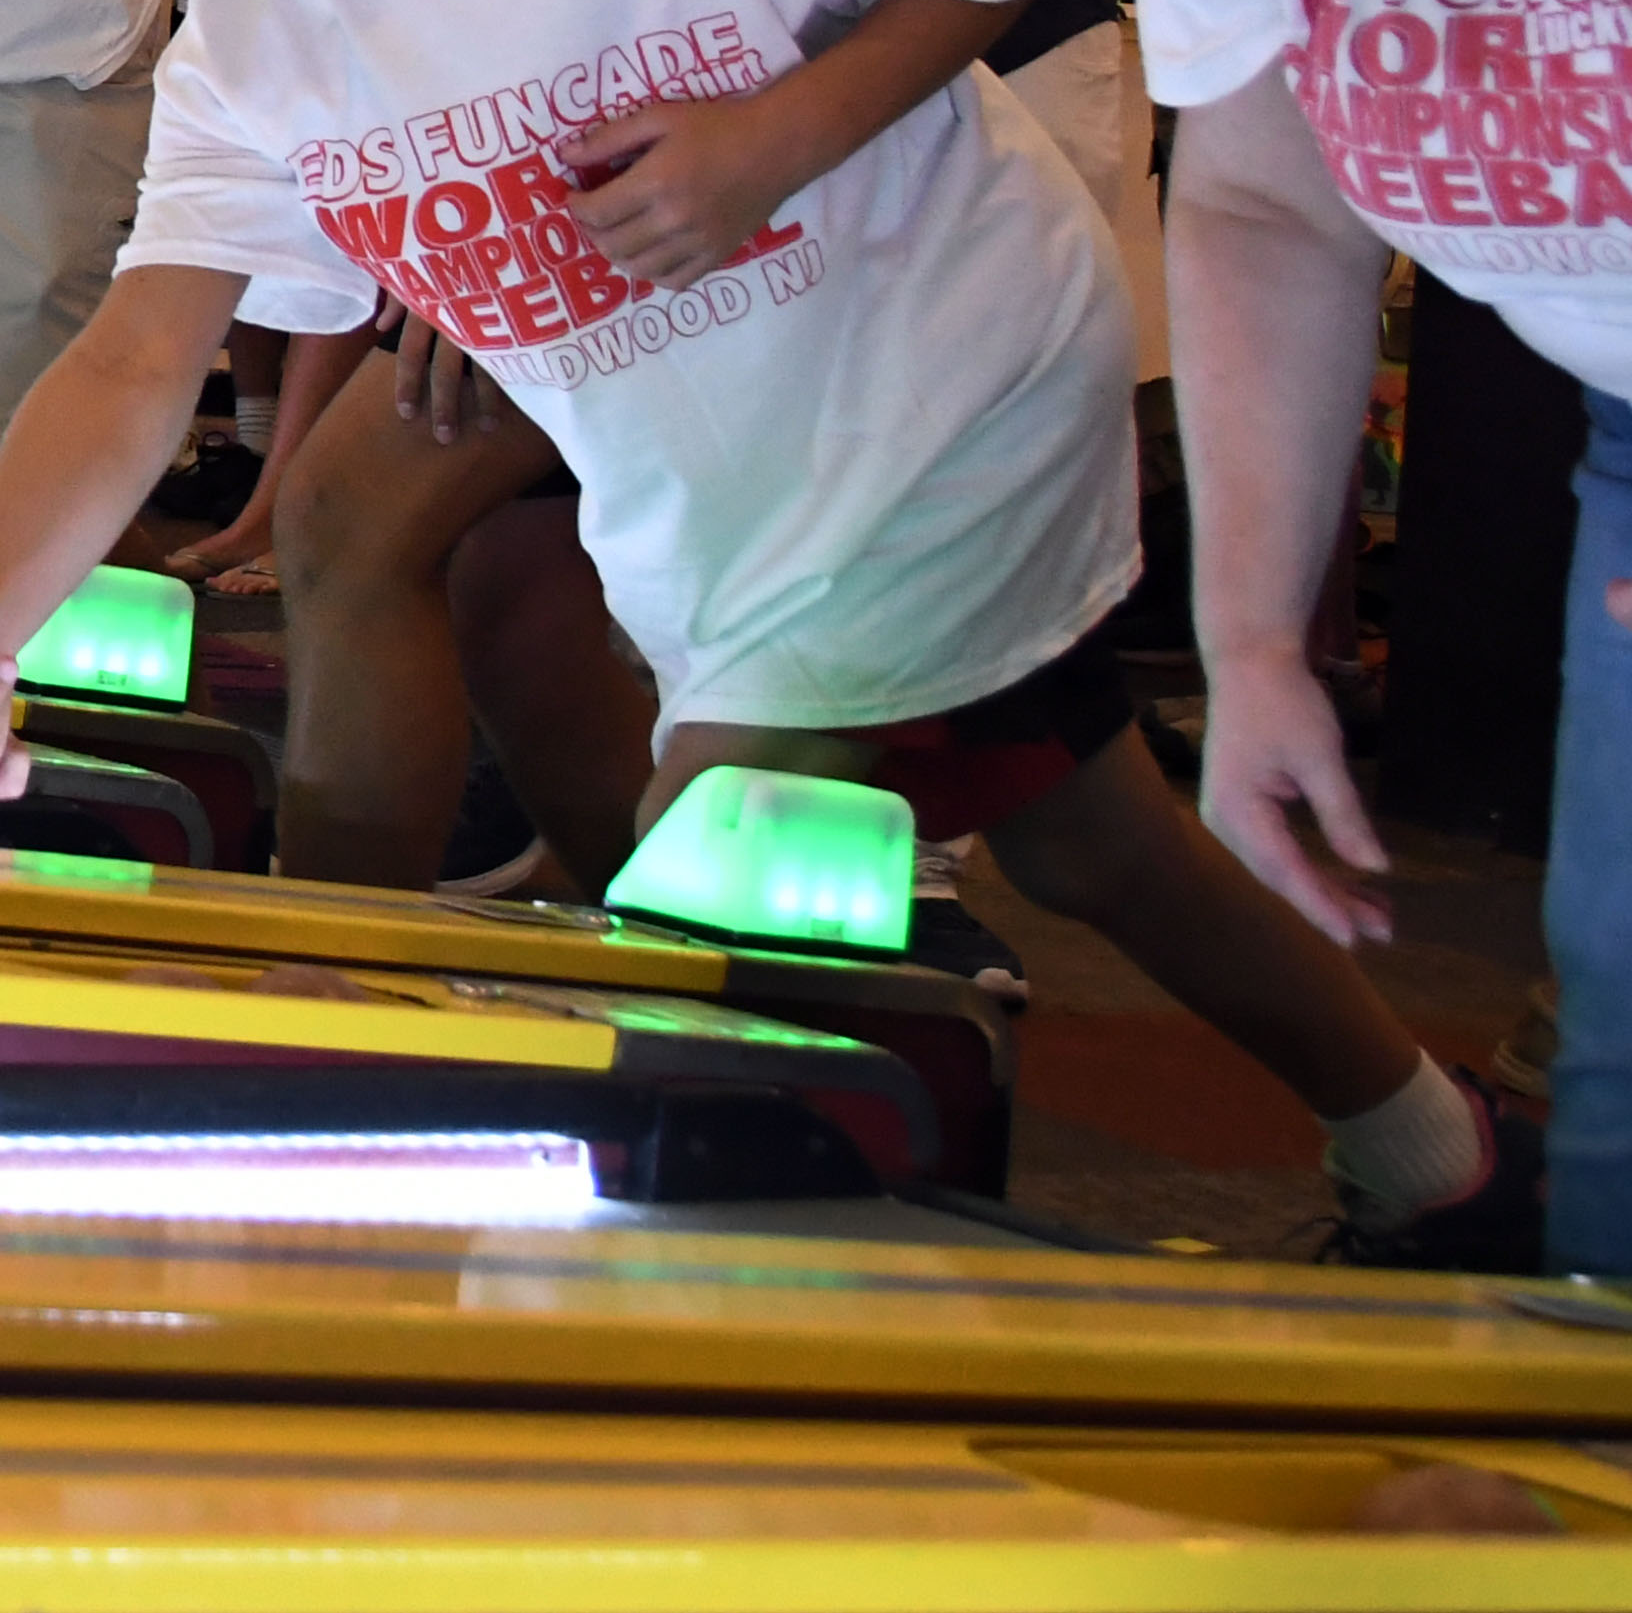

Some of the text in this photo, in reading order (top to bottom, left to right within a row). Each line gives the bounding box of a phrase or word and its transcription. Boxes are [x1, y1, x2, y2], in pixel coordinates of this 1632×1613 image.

[285, 125, 405, 203] EDS
[405, 10, 745, 182] FUNCADE
[762, 239, 825, 306] NJ
